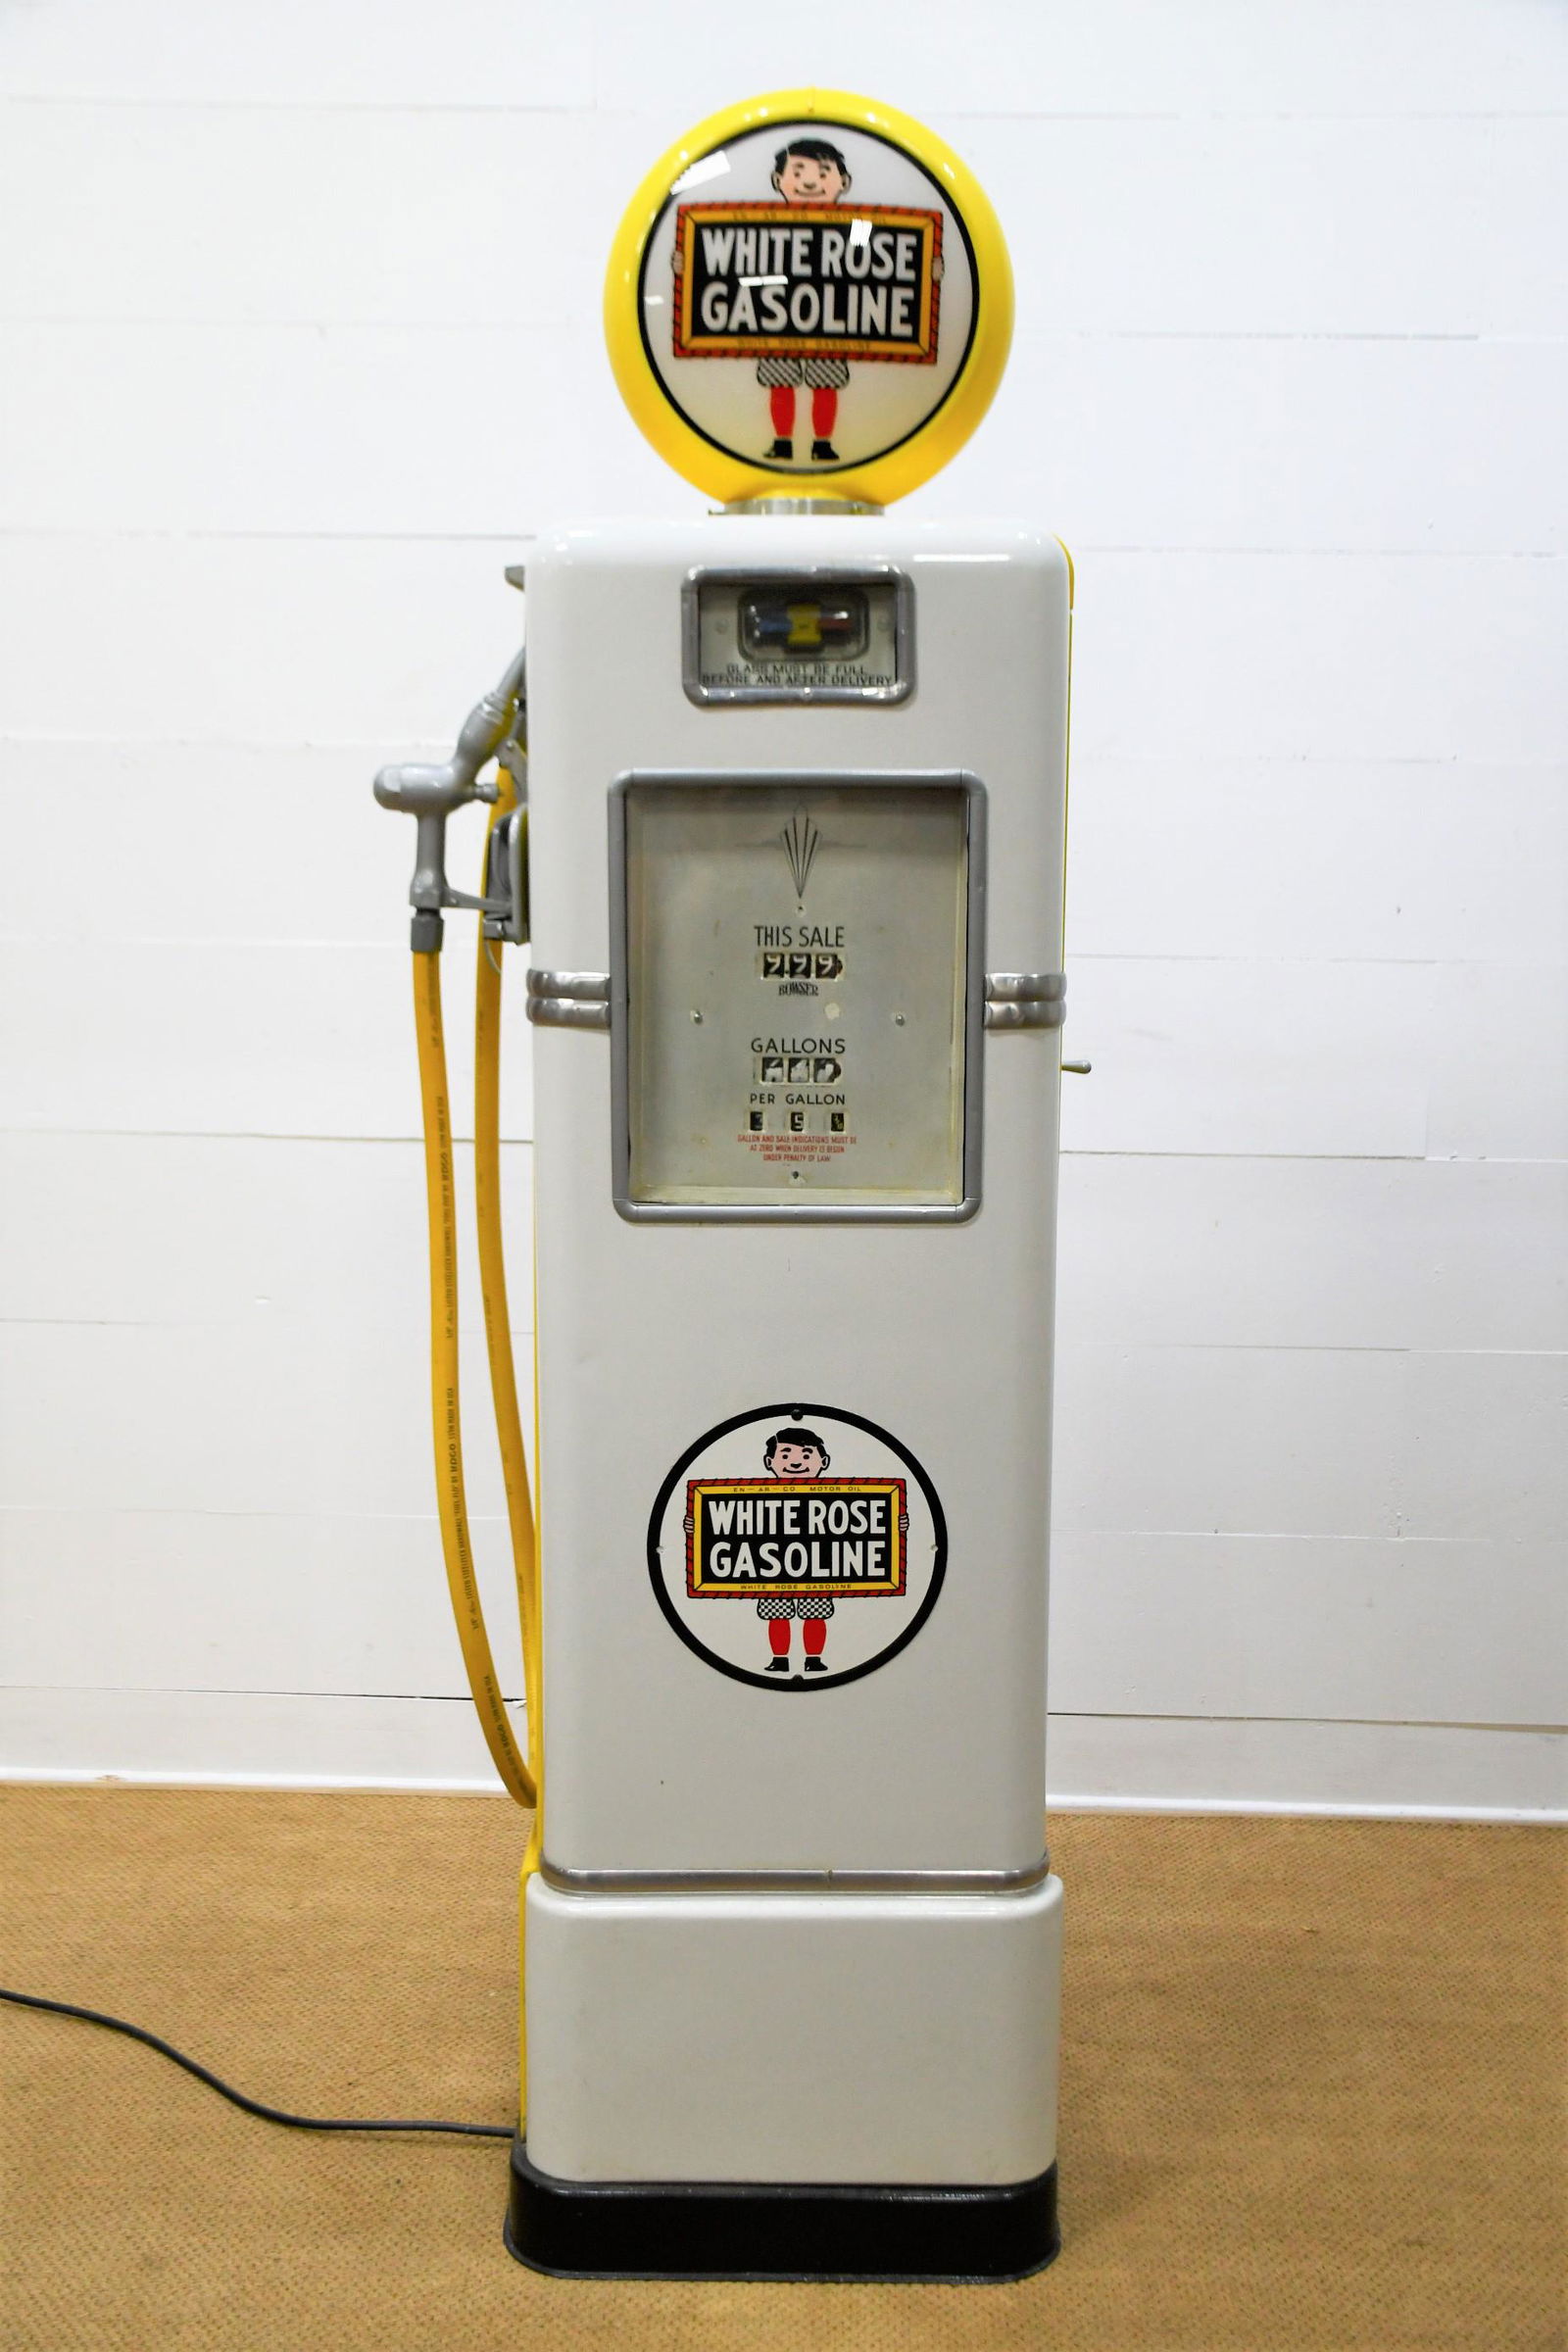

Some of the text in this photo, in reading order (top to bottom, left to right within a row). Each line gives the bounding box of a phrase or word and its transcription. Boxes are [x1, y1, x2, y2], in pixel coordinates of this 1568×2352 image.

[701, 226, 917, 281] WHITE ROSE
[701, 281, 916, 336] GASOLINE
[772, 663, 807, 674] MUST
[836, 663, 864, 674] FULL
[702, 673, 893, 685] BEFORE AND AFTER DELIVERY
[754, 925, 845, 948] THIS SALE
[779, 981, 818, 996] BOWSER
[751, 1038, 846, 1054] GALLONS
[750, 1094, 846, 1105] PER GALLON
[708, 1499, 886, 1536] WHITE ROSE
[709, 1541, 886, 1578] GASOLINE
